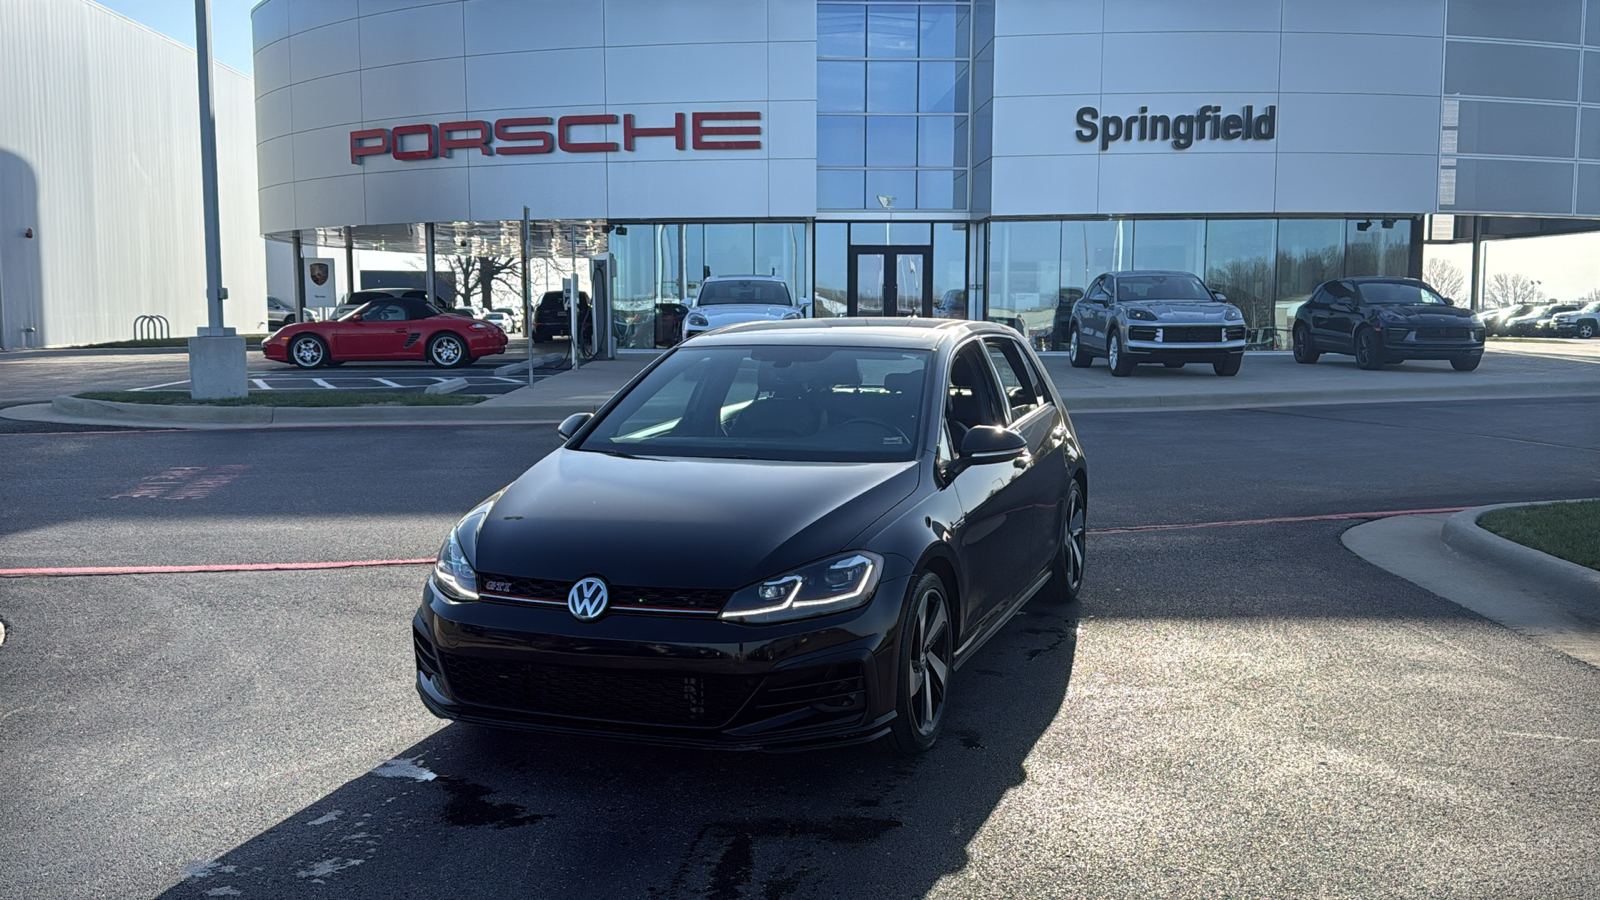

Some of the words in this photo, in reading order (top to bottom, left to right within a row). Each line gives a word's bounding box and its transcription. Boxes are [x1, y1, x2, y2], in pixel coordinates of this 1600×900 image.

[350, 111, 762, 165] PORSCHE
[1075, 105, 1276, 151] Springfield
[485, 580, 512, 593] GTI
